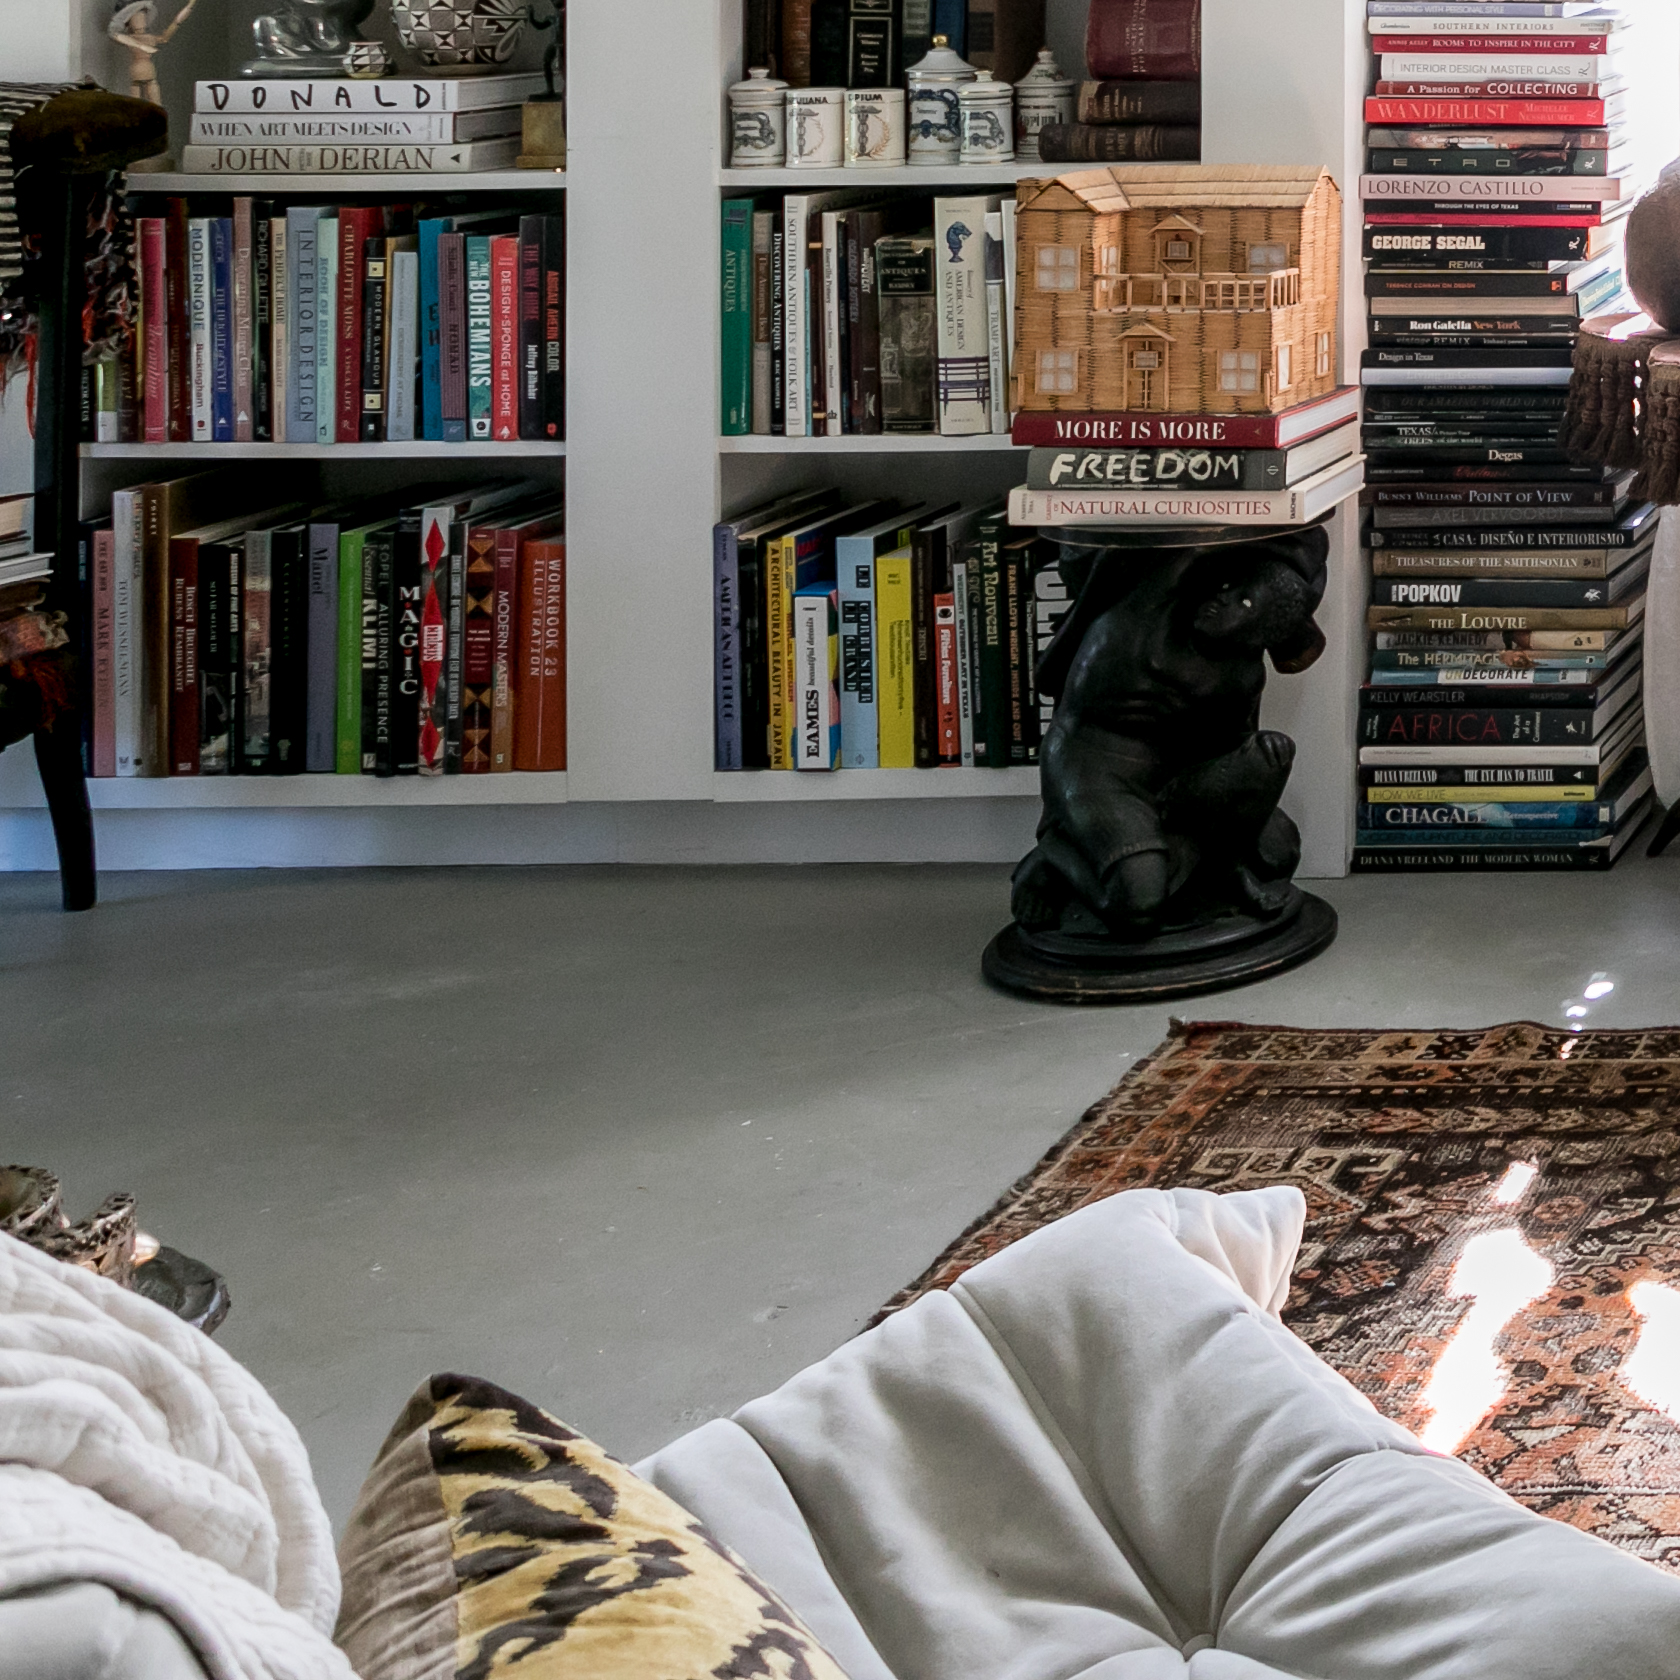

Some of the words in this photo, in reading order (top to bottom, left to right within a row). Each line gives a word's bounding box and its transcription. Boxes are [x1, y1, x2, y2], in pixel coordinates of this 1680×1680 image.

[1400, 64, 1446, 73] INTERIOR
[1450, 64, 1487, 74] DESIGN
[1491, 65, 1533, 74] MASTER
[1537, 66, 1570, 75] CLASS
[207, 83, 431, 110] DONALD
[1420, 85, 1460, 93] Passion
[1464, 85, 1480, 93] for
[1487, 83, 1577, 94] COLLECTING
[1378, 103, 1508, 119] WANDERLUST
[201, 123, 252, 136] WHEN
[259, 123, 290, 136] ART
[293, 123, 348, 135] MEETS
[352, 123, 412, 135] DESIGN
[211, 148, 293, 170] JOHN
[320, 148, 435, 169] DERIAN
[1368, 180, 1450, 194] LORENZO
[1459, 181, 1543, 195] CASTILLO
[788, 219, 796, 281] SOUTHERN
[1372, 236, 1432, 250] GEORGE
[1436, 236, 1485, 250] SEGAL
[471, 261, 480, 277] NEW
[480, 263, 489, 277] THE
[1449, 260, 1484, 269] REMIX
[192, 228, 205, 330] MODERNIQUE
[299, 230, 313, 334] INTERIOR
[724, 249, 736, 312] ANTIQUES
[955, 270, 963, 315] AMERICAN
[787, 285, 797, 343] ANTIQUES
[946, 292, 954, 336] ANTIQUES
[469, 280, 490, 387] BOHEMIANS
[992, 346, 1000, 362] ART
[1379, 352, 1404, 362] Design
[1405, 353, 1413, 361] in
[1414, 353, 1434, 361] Texas
[195, 344, 204, 407] Buckingham
[299, 345, 313, 422] DESIGN
[788, 358, 797, 385] FOLK
[789, 390, 797, 411] ART
[1054, 420, 1122, 439] MORE
[1131, 420, 1151, 439] IS
[1158, 421, 1226, 440] MORE
[1050, 452, 1239, 485] FREEDOM
[1488, 450, 1523, 461] Degas
[1060, 500, 1150, 515] NATURAL
[1156, 501, 1271, 516] CURIOSITIES
[312, 548, 328, 594] Manet
[1396, 557, 1461, 567] TREASURES
[1462, 557, 1476, 567] OF
[1479, 557, 1501, 567] THE
[1504, 558, 1578, 567] SMITHSONIAN
[175, 578, 184, 619] RUBENS
[545, 559, 561, 649] WORKBOOK
[771, 548, 782, 645] ARCHITECTURAL
[1399, 585, 1462, 602] POPKOV
[497, 590, 509, 648] MODERN
[530, 559, 544, 676] ILLUSTRATION
[1429, 619, 1454, 629] THE
[1461, 613, 1527, 629] LOUVRE
[940, 629, 950, 658] Fifties
[1395, 633, 1429, 646] JACKIE
[1438, 633, 1488, 646] KENNEDY
[175, 626, 184, 692] REMBRANDT
[807, 645, 815, 686] beautiful
[496, 652, 508, 707] MASTERS
[772, 651, 781, 697] BEAUTY
[942, 660, 952, 704] Furniture
[773, 703, 781, 716] IN
[806, 689, 820, 758] EAMES
[1388, 714, 1501, 740] AFRICA
[773, 724, 782, 764] JAPAN
[1373, 790, 1403, 800] HOW
[1406, 790, 1423, 800] WE
[1425, 790, 1446, 800] LIVE
[1361, 856, 1396, 865] DIANA
[1398, 855, 1453, 865] VREELAND
[1460, 855, 1480, 864] THE
[1484, 855, 1529, 863] MODERN
[1534, 855, 1572, 863] WOMAN
